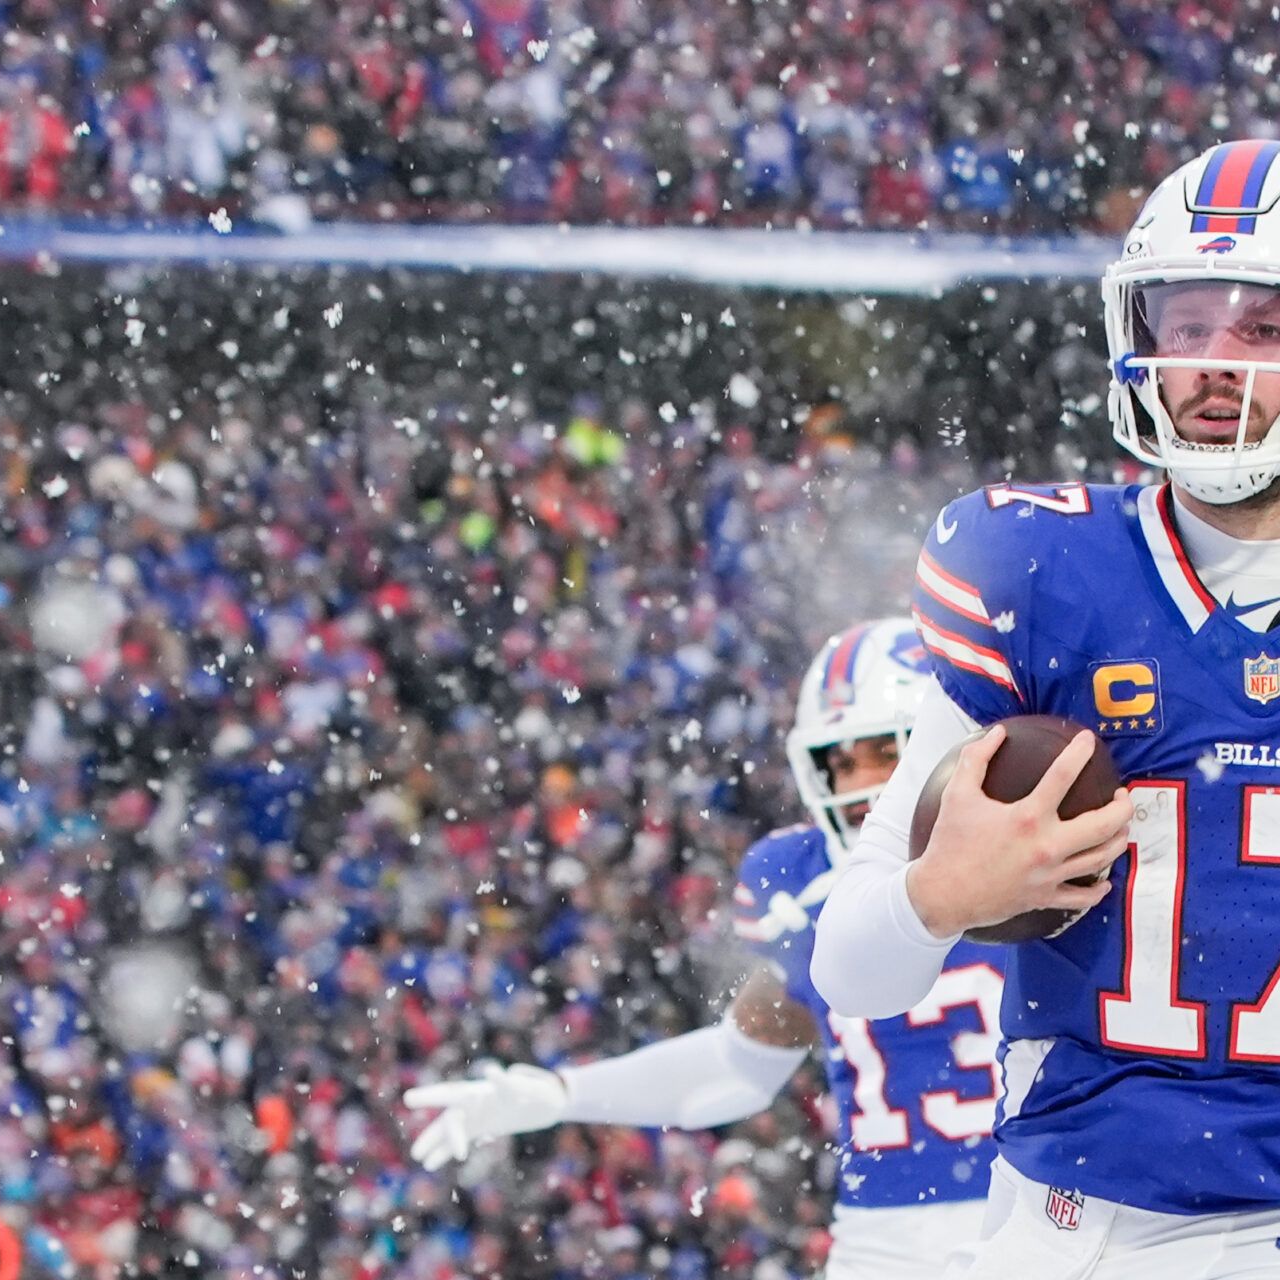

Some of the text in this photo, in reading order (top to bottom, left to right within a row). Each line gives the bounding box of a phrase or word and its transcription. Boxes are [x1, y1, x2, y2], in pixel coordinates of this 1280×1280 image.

[1093, 663, 1156, 718] C
[1250, 676, 1276, 693] NFL
[827, 963, 1005, 1151] 13
[1049, 1193, 1077, 1227] NFL
